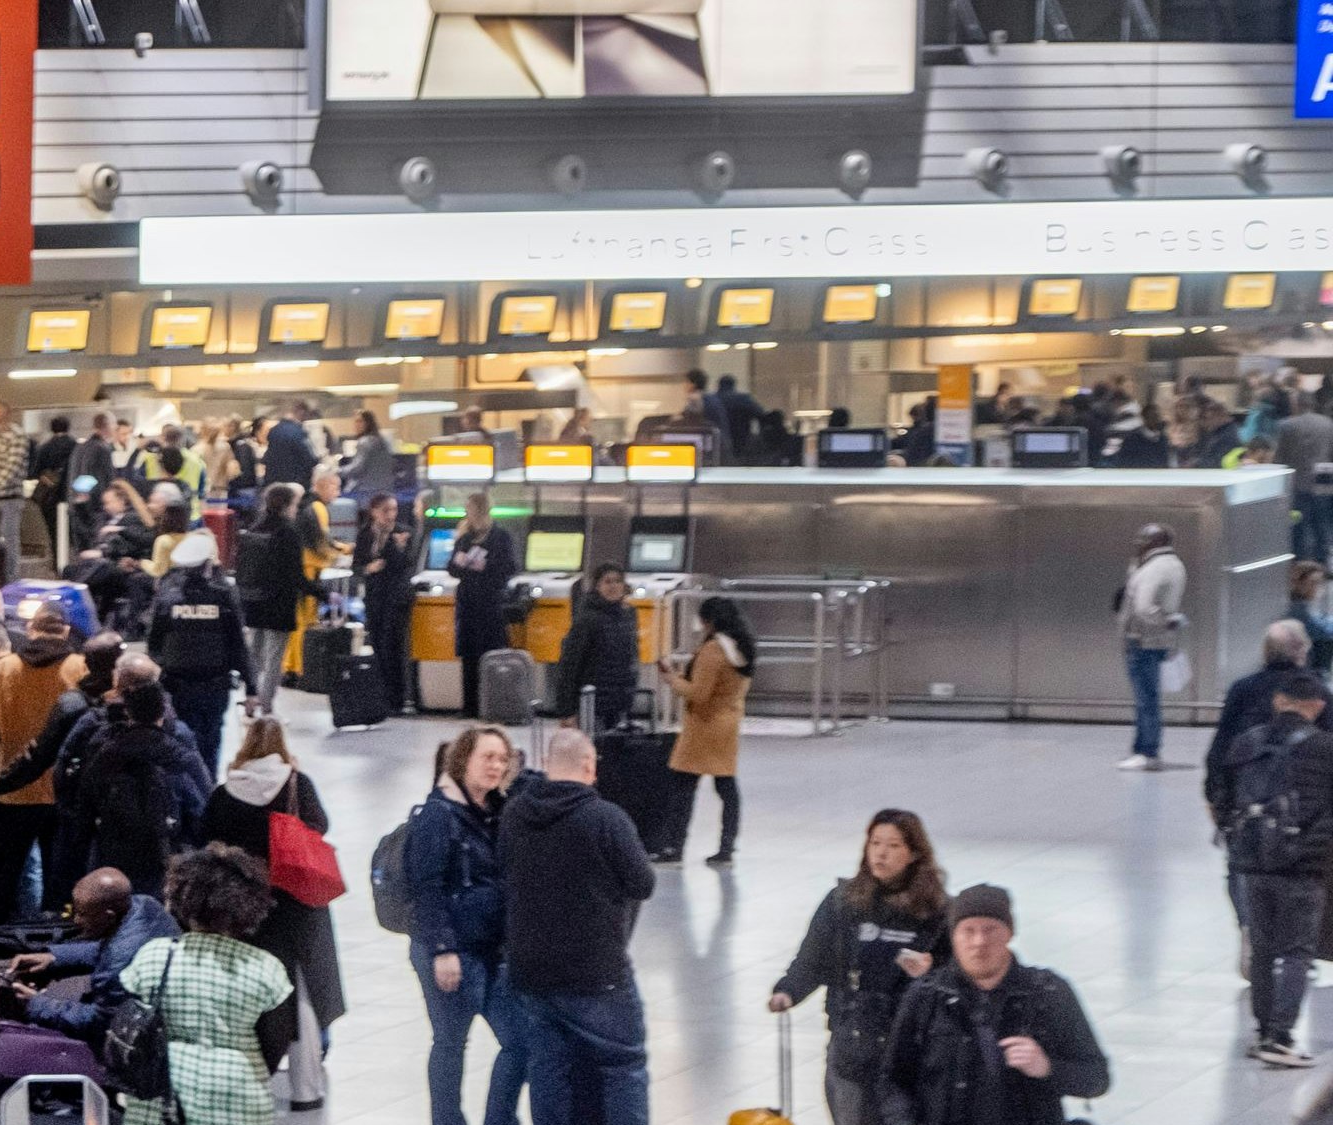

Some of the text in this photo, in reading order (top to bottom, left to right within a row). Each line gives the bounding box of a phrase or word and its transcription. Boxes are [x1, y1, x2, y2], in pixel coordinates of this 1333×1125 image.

[527, 227, 931, 260] Lfthansa Frst Cass
[1045, 223, 1226, 253] Bsness
[171, 604, 220, 619] POLIZEI
